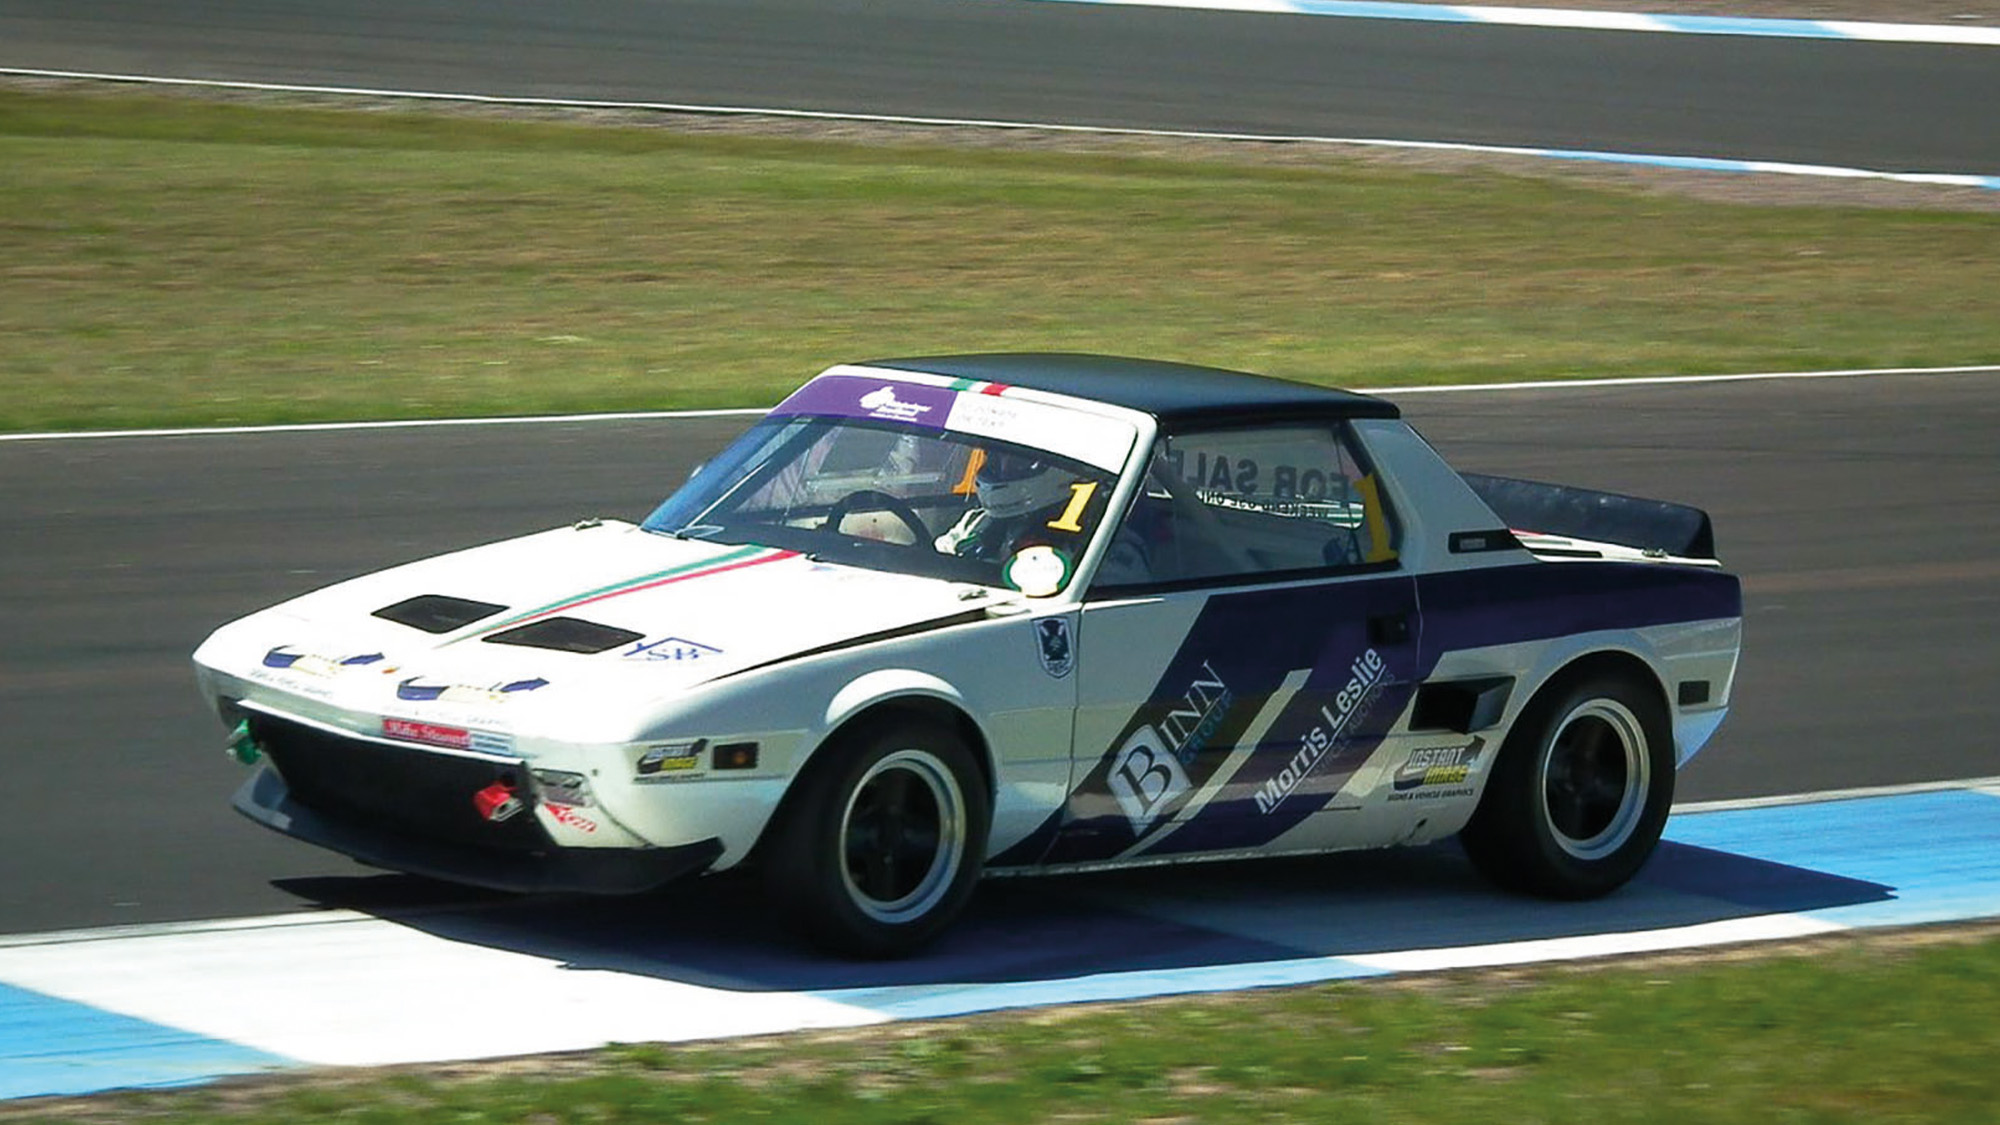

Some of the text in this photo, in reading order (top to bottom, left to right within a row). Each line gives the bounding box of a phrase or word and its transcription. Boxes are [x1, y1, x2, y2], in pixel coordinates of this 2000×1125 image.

[1047, 481, 1097, 534] 1
[1353, 473, 1399, 563] 1
[1116, 660, 1227, 817] BINN
[1254, 647, 1385, 816] Morris Leslie
